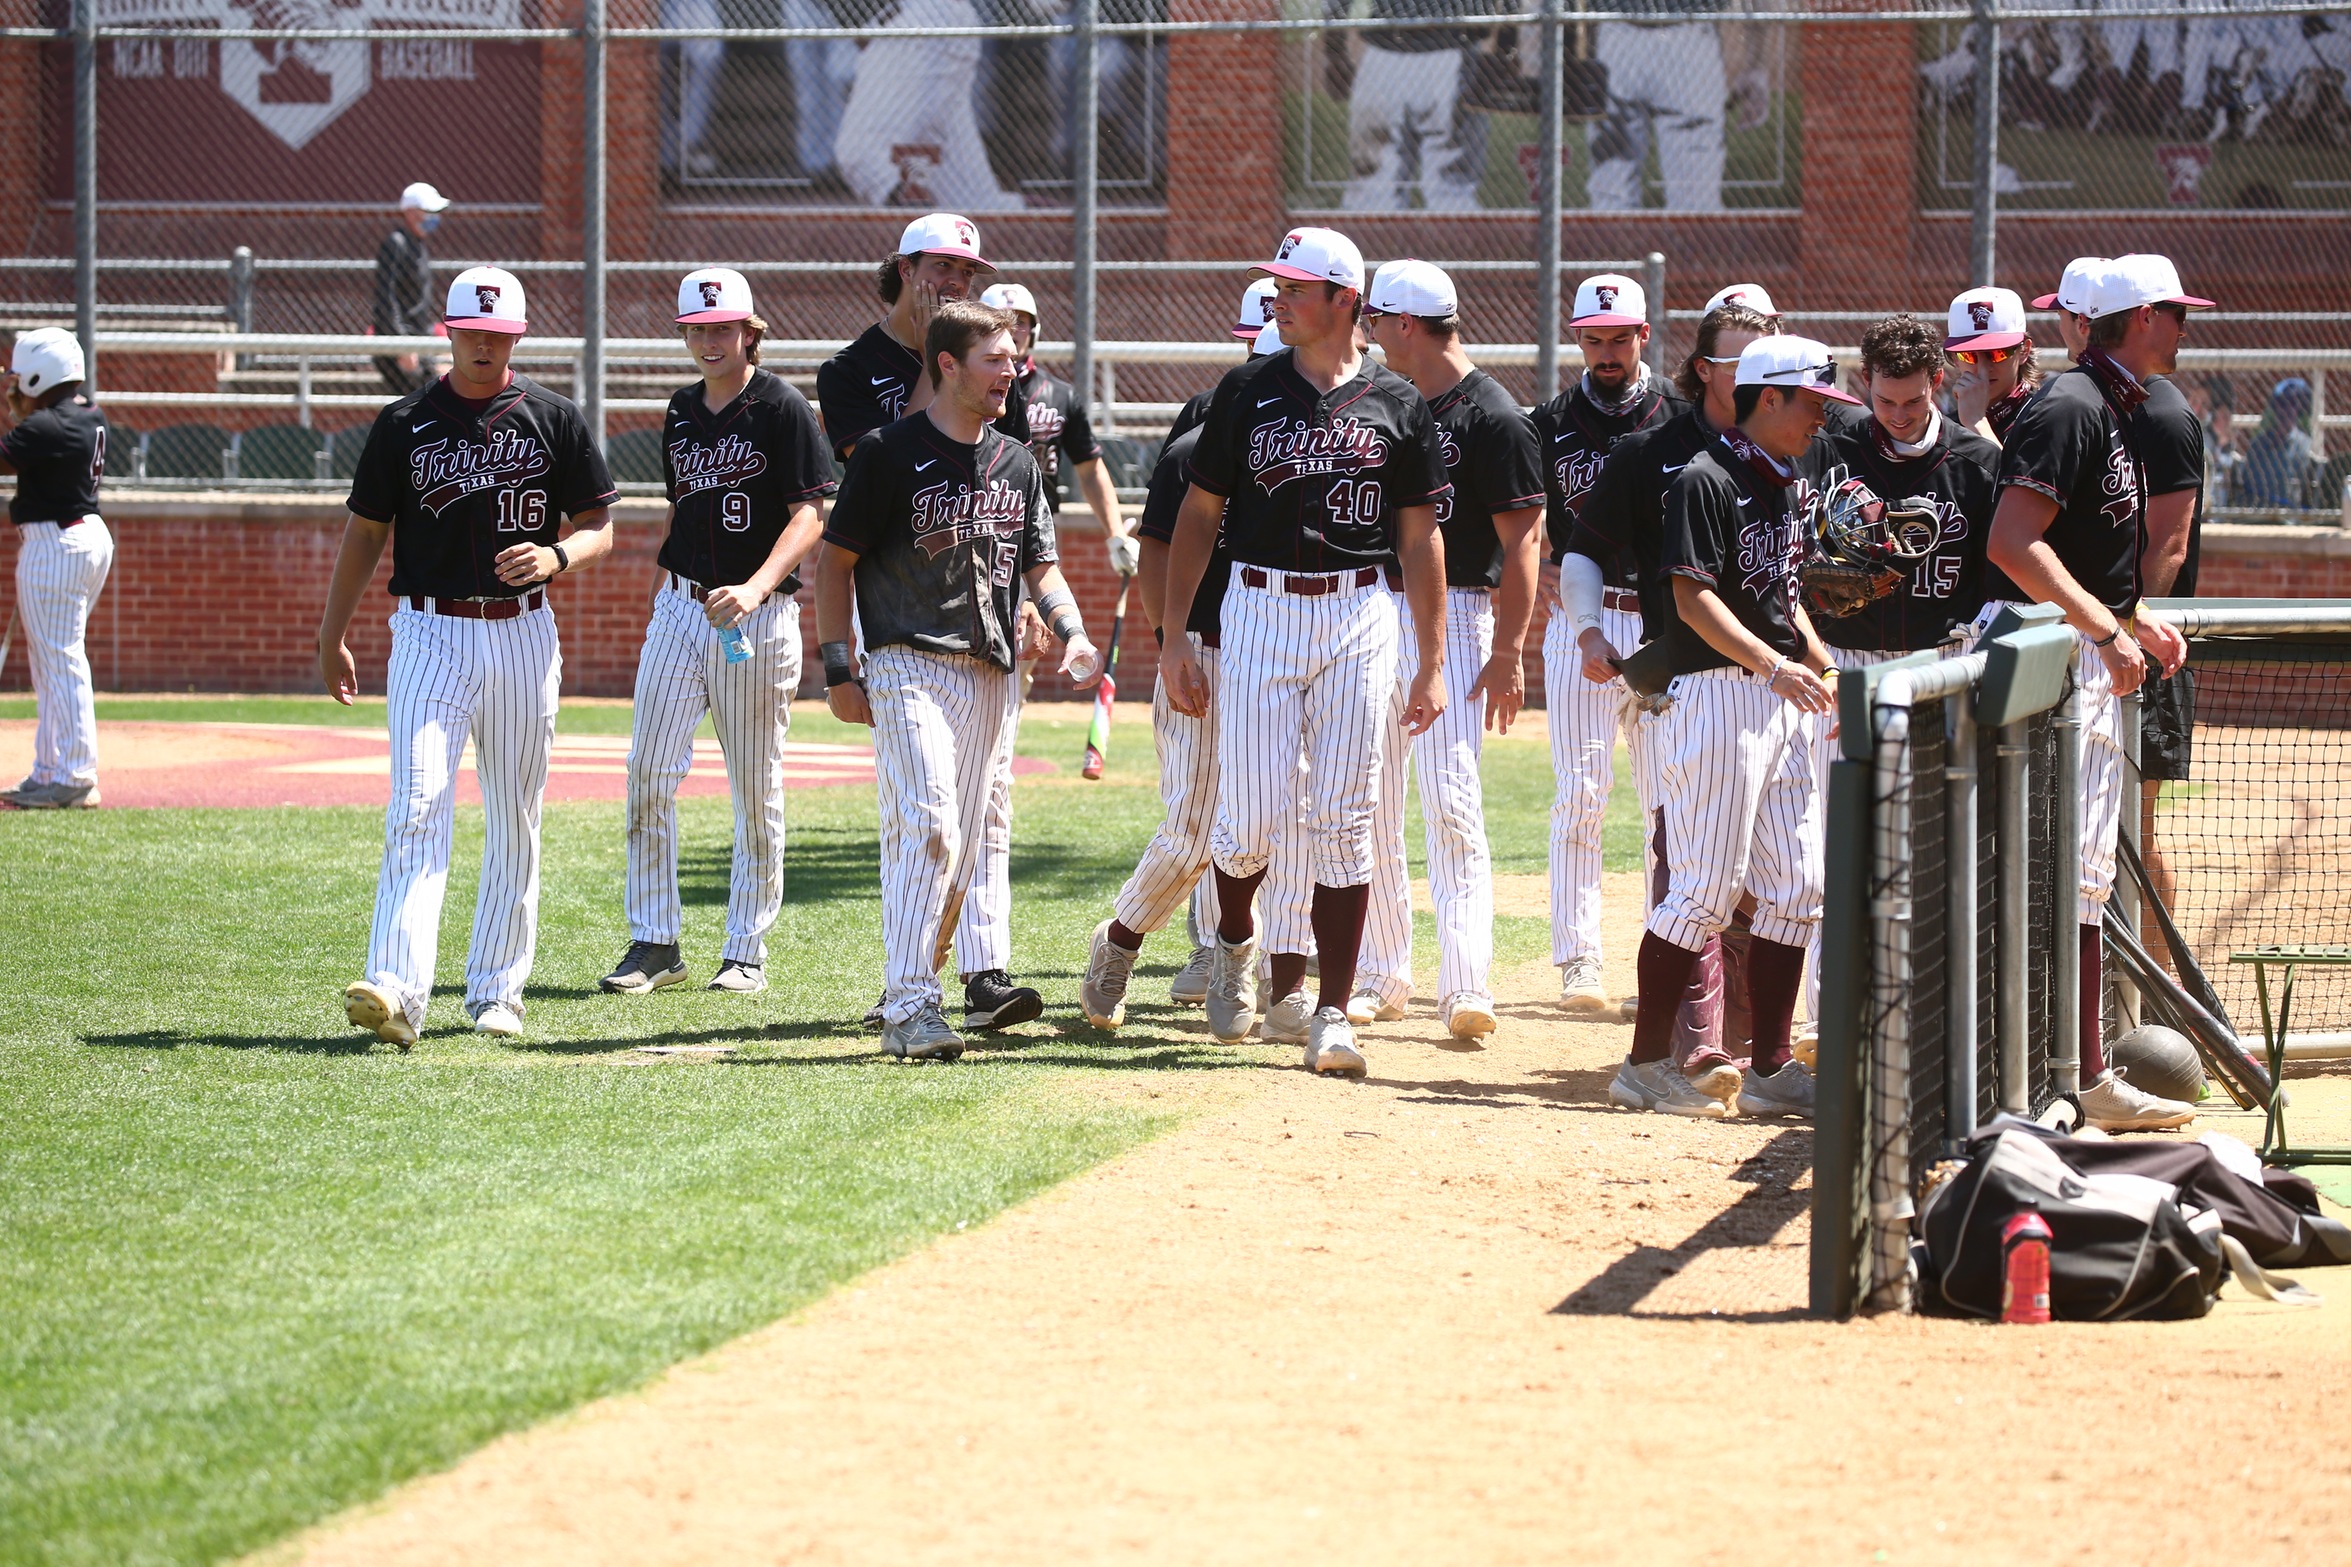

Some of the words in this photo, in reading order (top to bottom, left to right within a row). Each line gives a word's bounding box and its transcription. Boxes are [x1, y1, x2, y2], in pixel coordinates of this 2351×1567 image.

[380, 38, 476, 80] BASEBALL
[410, 429, 551, 489] Trinity
[669, 434, 767, 488] Trinity
[1248, 416, 1389, 475] Trinity
[497, 489, 547, 532] 16
[722, 492, 751, 532] 9
[911, 479, 1026, 540] Trinity
[1326, 479, 1382, 525] 40
[958, 523, 994, 540] TEXAS
[991, 541, 1018, 588] 5
[1911, 556, 1962, 599] 15
